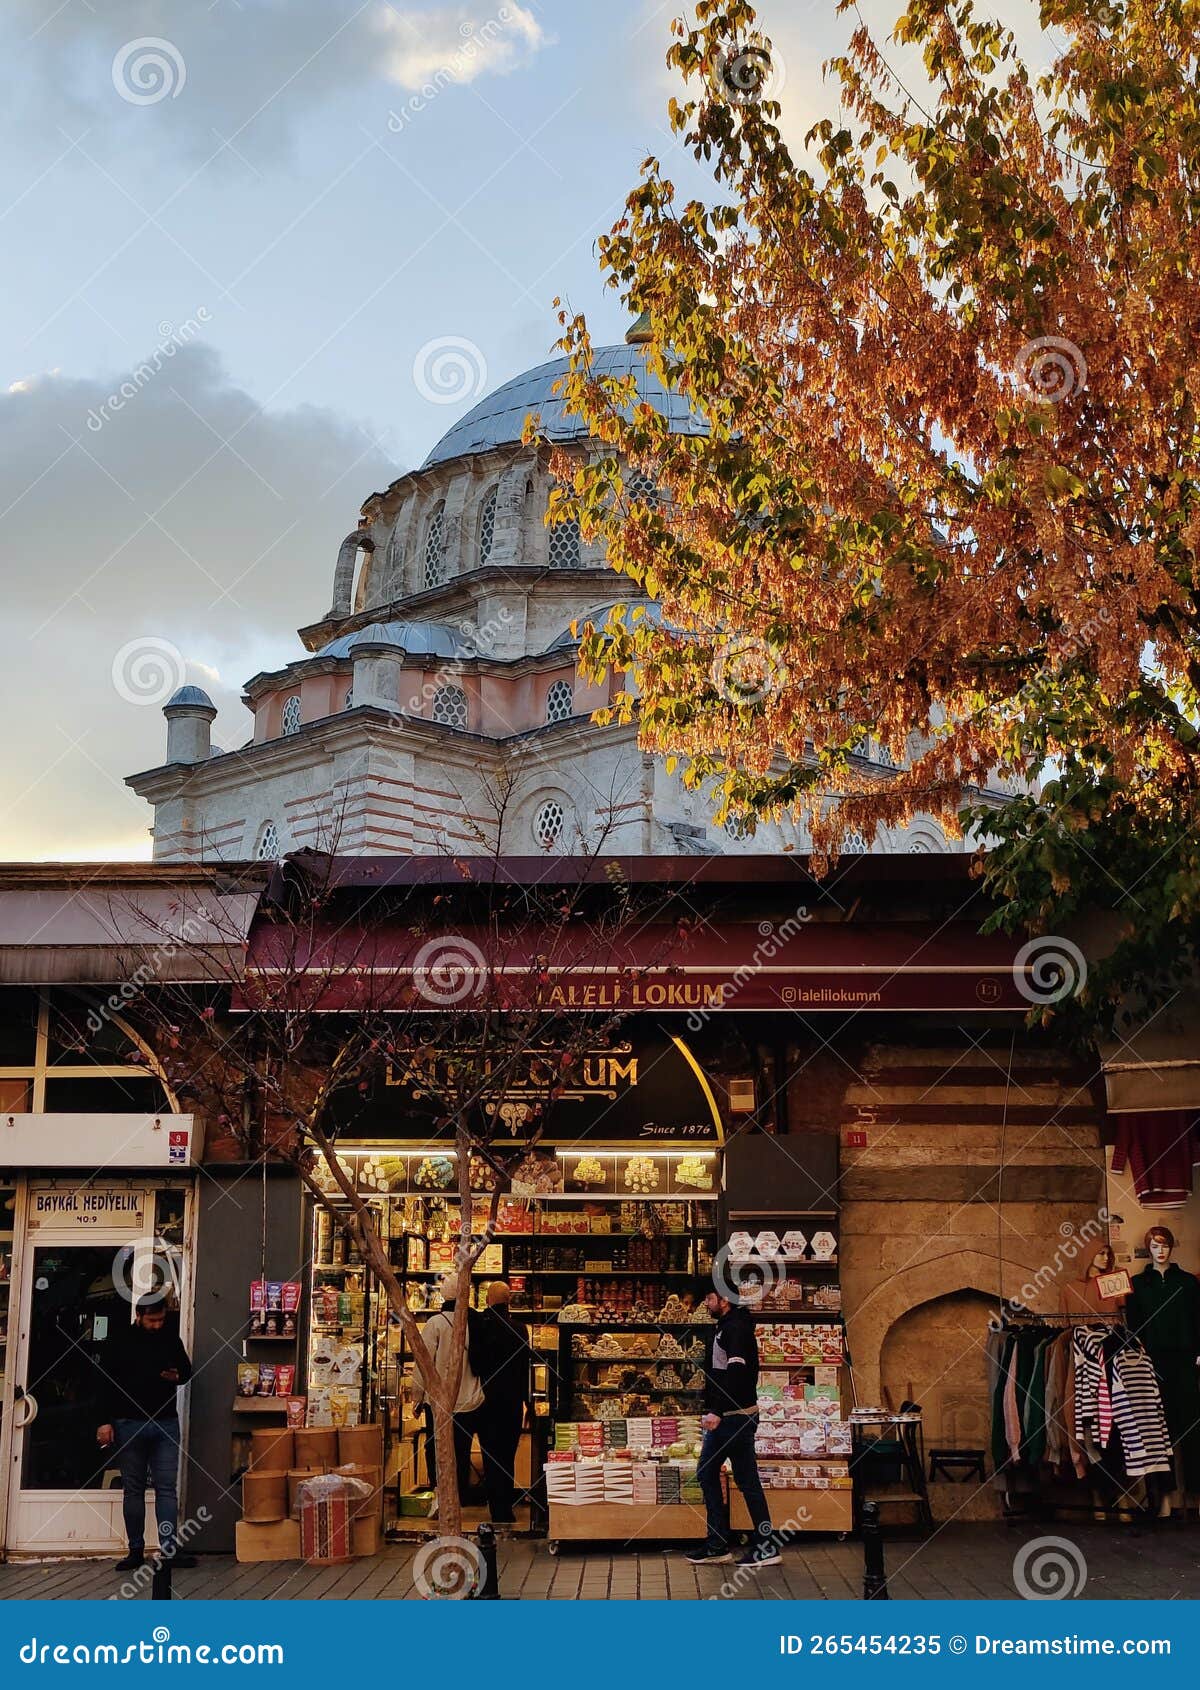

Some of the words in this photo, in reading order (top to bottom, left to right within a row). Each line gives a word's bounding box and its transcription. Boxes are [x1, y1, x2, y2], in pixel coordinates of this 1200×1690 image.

[632, 984, 723, 1005] LOKUM
[798, 988, 881, 1002] lalelilokumm
[511, 1058, 639, 1087] OUM
[639, 1122, 676, 1137] Since
[681, 1125, 711, 1135] 1876
